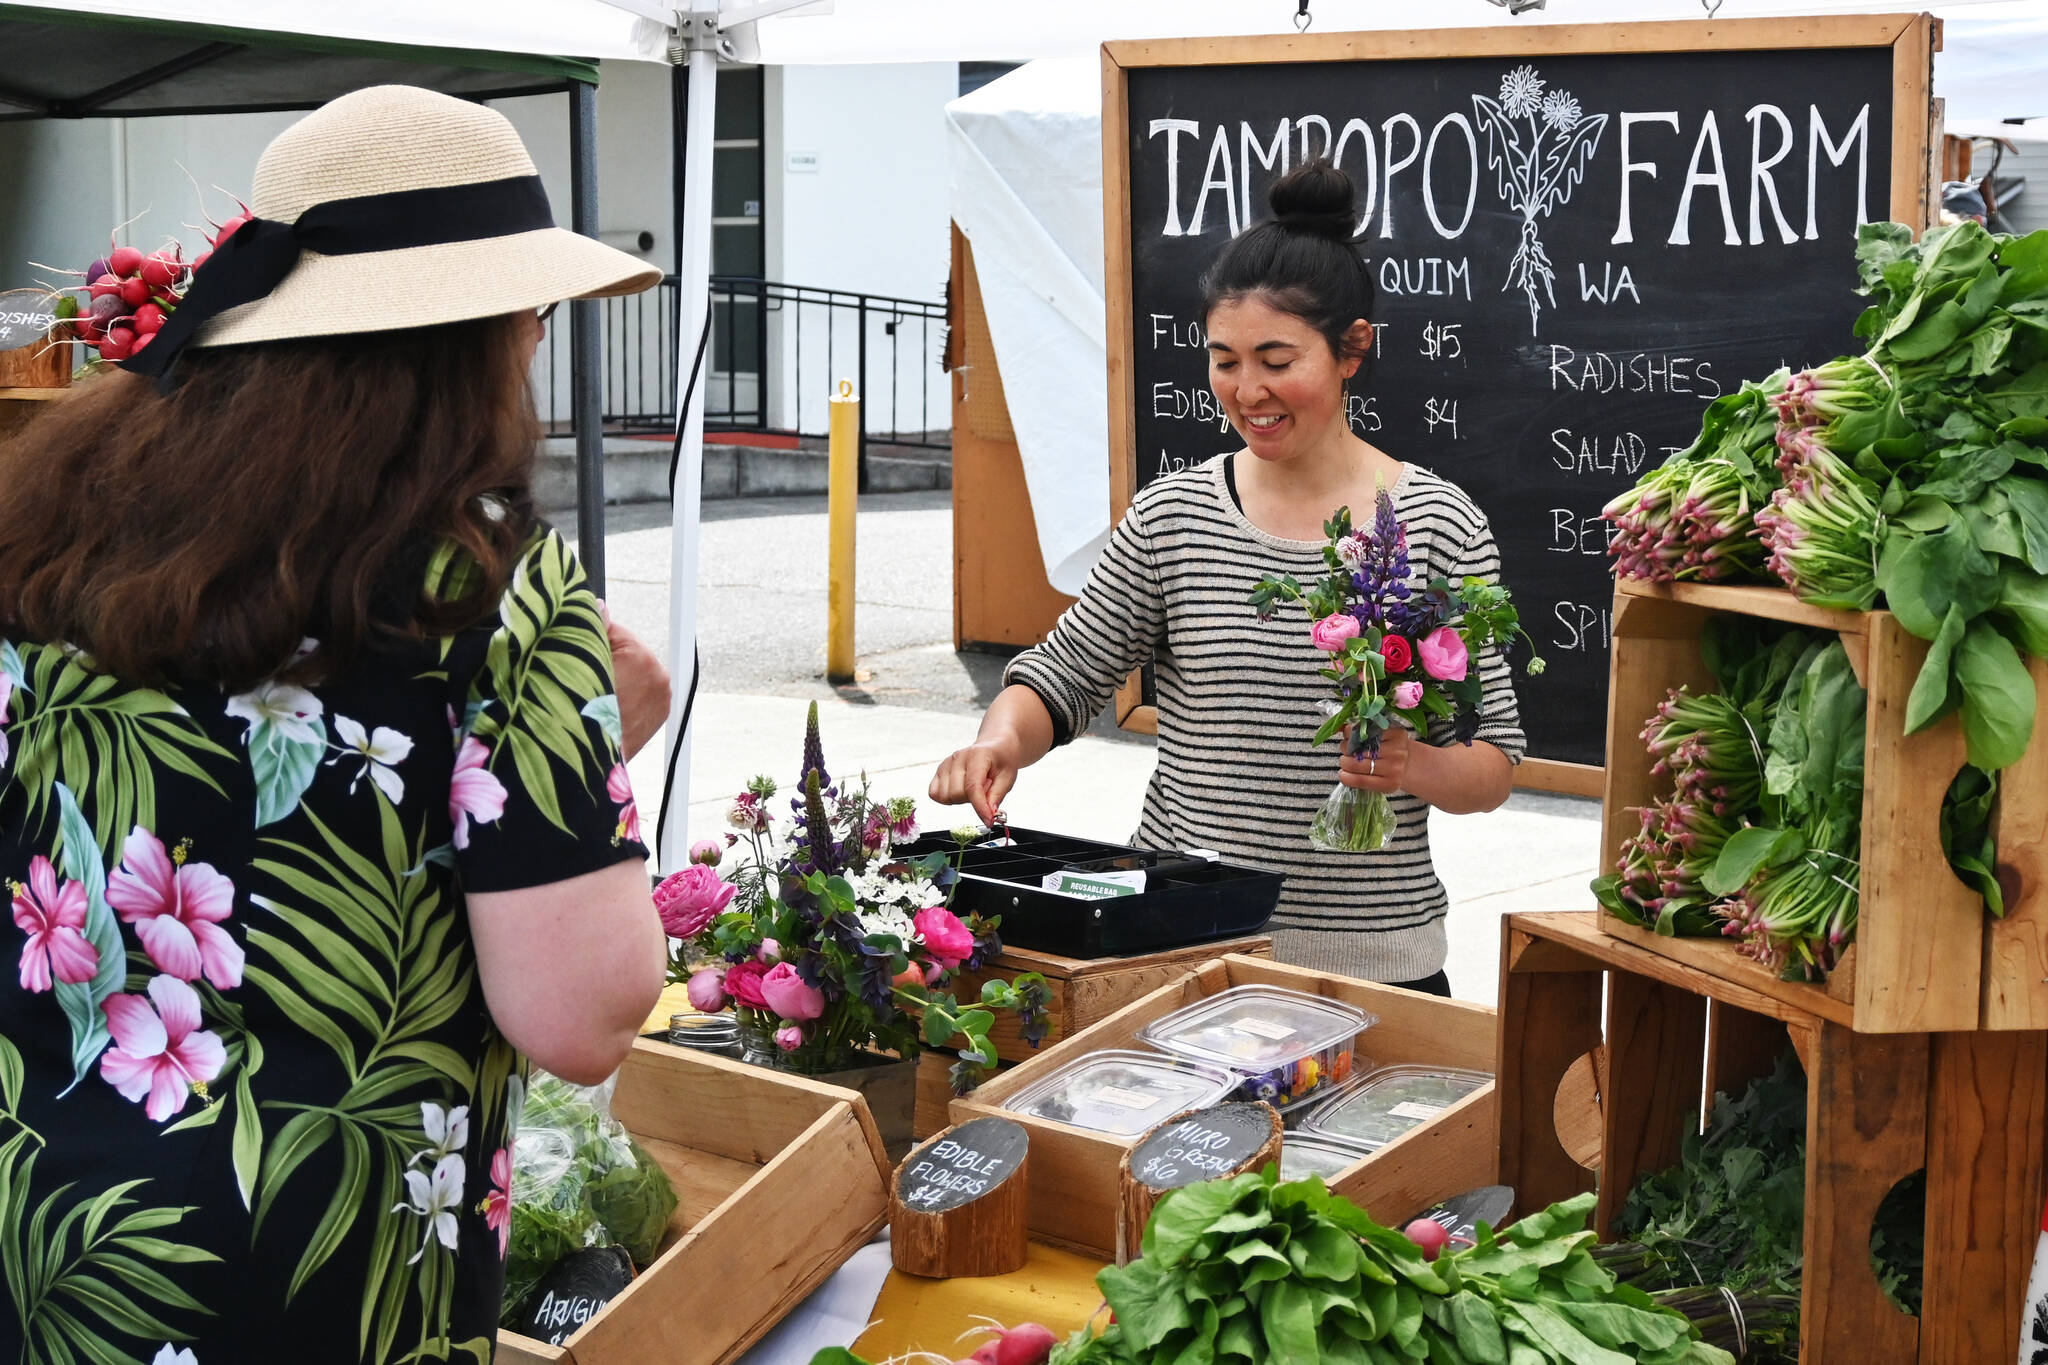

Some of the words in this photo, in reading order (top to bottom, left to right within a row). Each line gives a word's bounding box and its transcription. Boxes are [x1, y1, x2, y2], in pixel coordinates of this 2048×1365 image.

[1611, 103, 1870, 246] FARM
[1363, 257, 1472, 301] QUIM
[1578, 261, 1640, 304] WA
[1420, 320, 1462, 361] $15
[1550, 344, 1721, 399] RADISHES
[1424, 396, 1458, 440] $4
[1552, 429, 1646, 475] SALAD
[1553, 601, 1613, 652] SPI
[1166, 1121, 1231, 1150] MICRO
[910, 1161, 987, 1194] FLOWERS
[931, 1140, 1003, 1176] EDIBLE
[1143, 1156, 1178, 1179] $6
[1162, 1145, 1237, 1172] GREENS
[907, 1185, 948, 1208] $4
[534, 1290, 607, 1330] ARUGU
